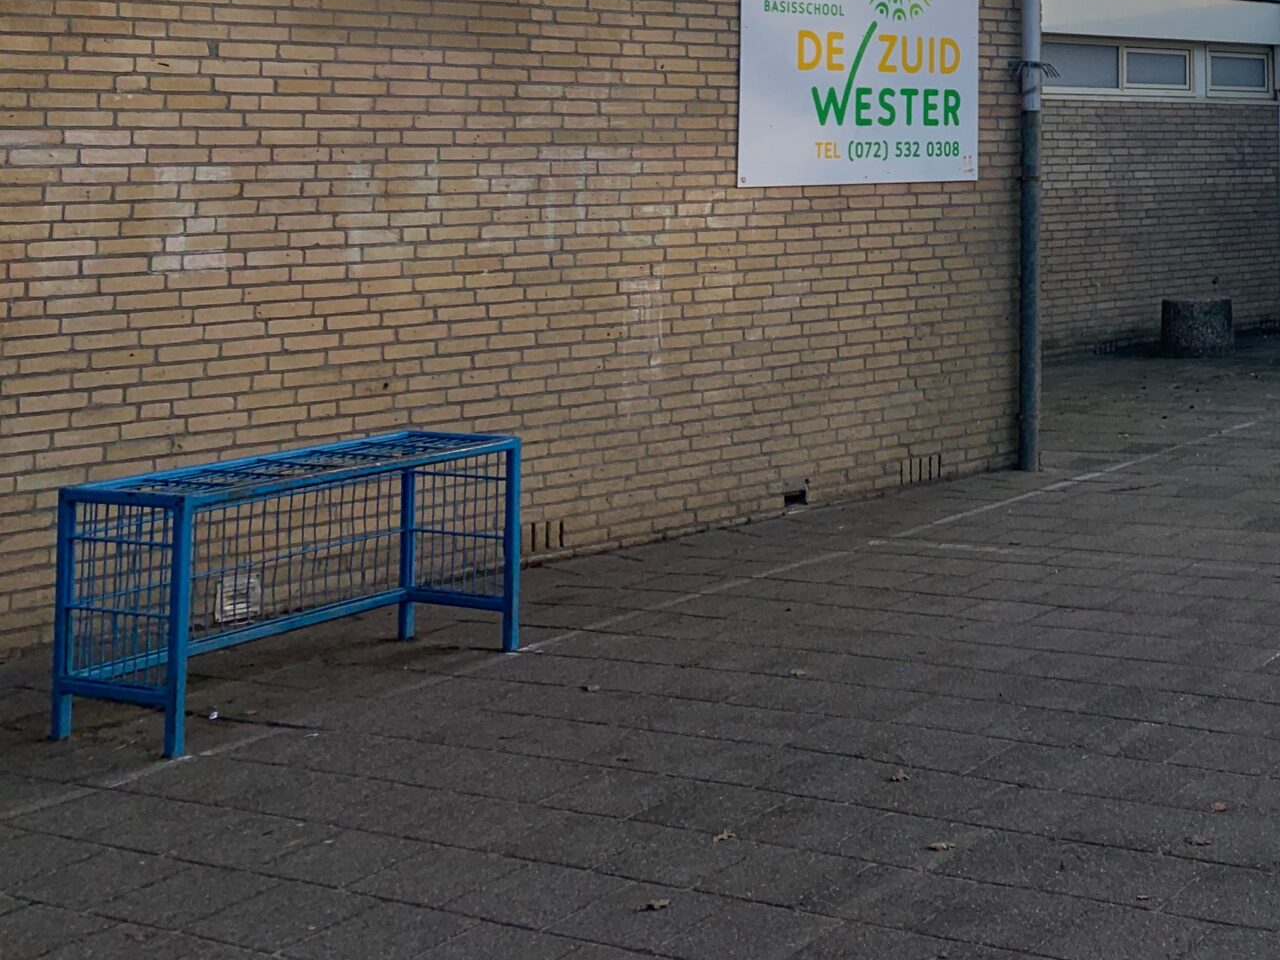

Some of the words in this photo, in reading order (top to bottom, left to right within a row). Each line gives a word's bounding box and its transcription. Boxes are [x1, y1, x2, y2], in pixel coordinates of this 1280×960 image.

[764, 0, 845, 16] BASISSCHOOL
[797, 29, 845, 71] DE
[878, 34, 961, 75] ZUID
[811, 86, 961, 127] WESTER
[815, 141, 841, 159] TEL
[848, 140, 888, 162] (072)
[895, 141, 920, 158] 532
[926, 141, 960, 158] 0308
